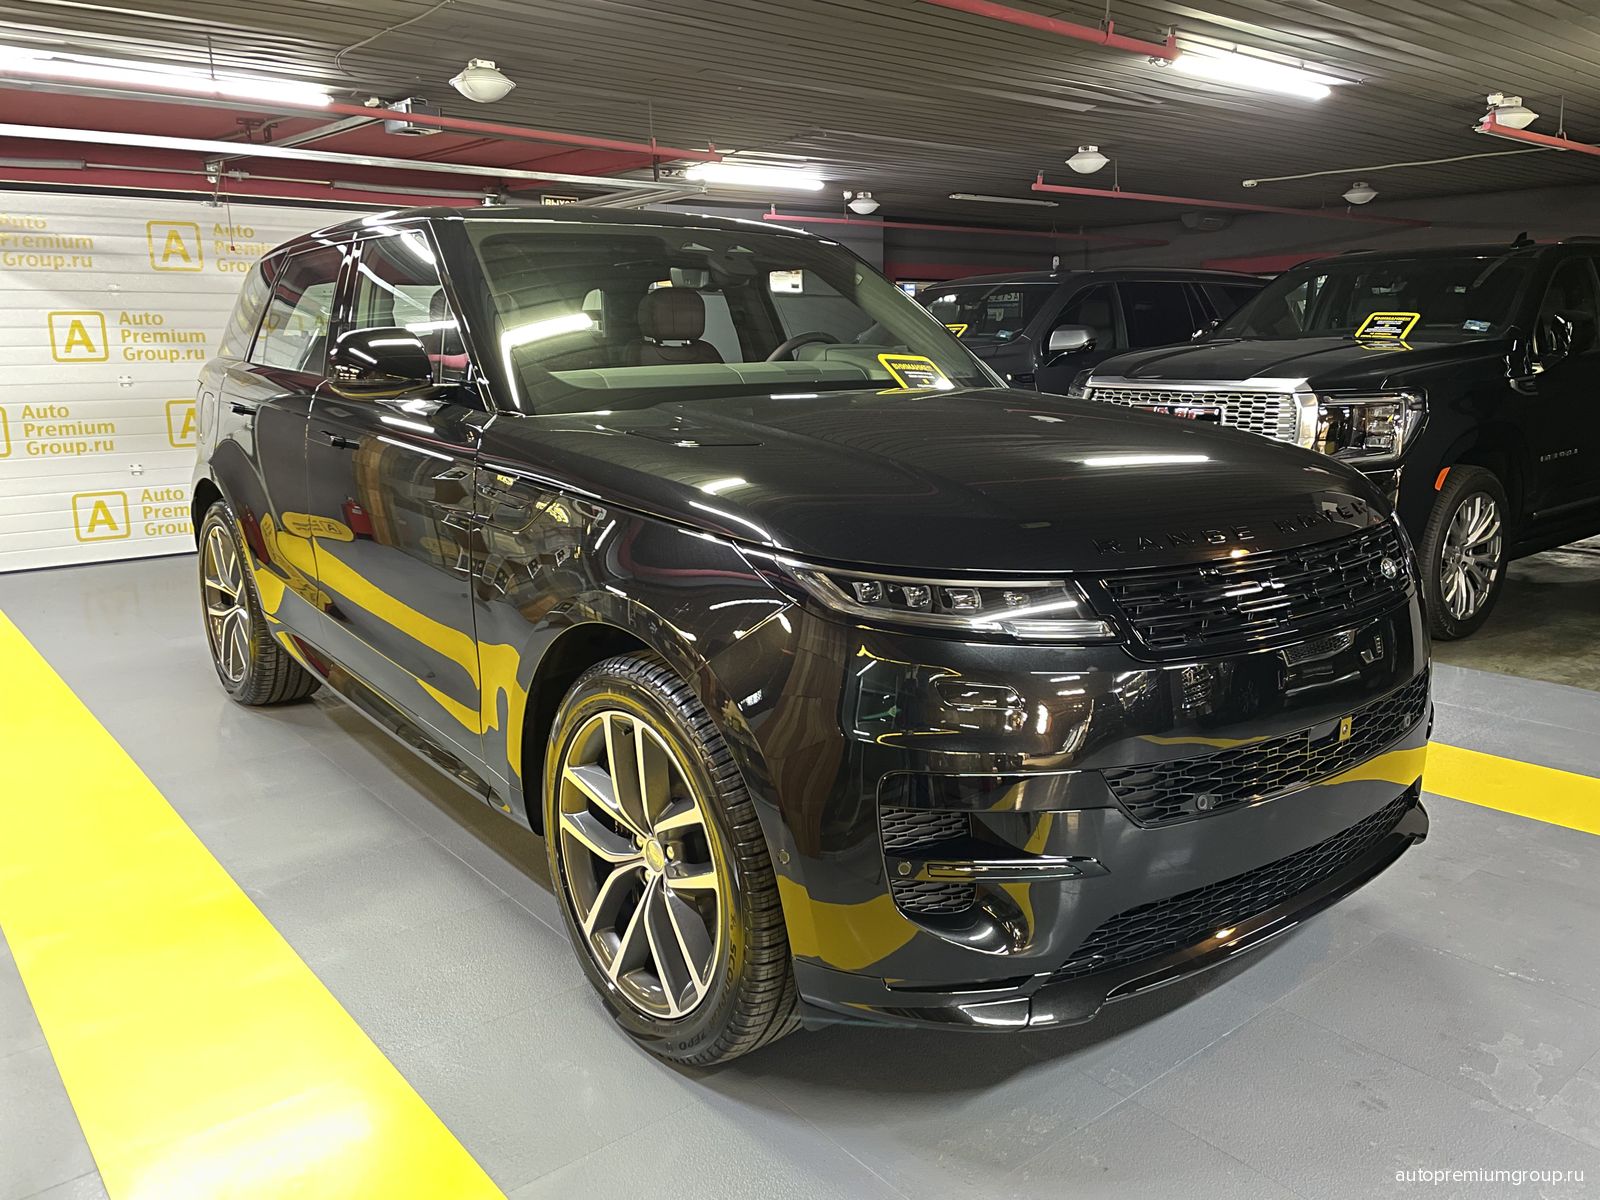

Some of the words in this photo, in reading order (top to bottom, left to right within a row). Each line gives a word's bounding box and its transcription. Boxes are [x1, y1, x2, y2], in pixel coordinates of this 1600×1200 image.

[545, 198, 576, 206] ВЫХ
[213, 223, 254, 238] Auto
[0, 232, 94, 249] Premium
[161, 229, 192, 262] A
[3, 251, 93, 270] Group.ru
[119, 311, 164, 326] Auto
[65, 319, 96, 353] A
[121, 329, 206, 343] Premium
[123, 346, 205, 363] Group.ru
[22, 404, 69, 419] Auto
[24, 421, 115, 437] Premium
[26, 440, 114, 456] Group.ru
[141, 488, 184, 502] Auto
[87, 500, 119, 533] A
[143, 506, 190, 519] Prem
[1092, 525, 1254, 555] RANGE
[1274, 500, 1367, 534] ROVER
